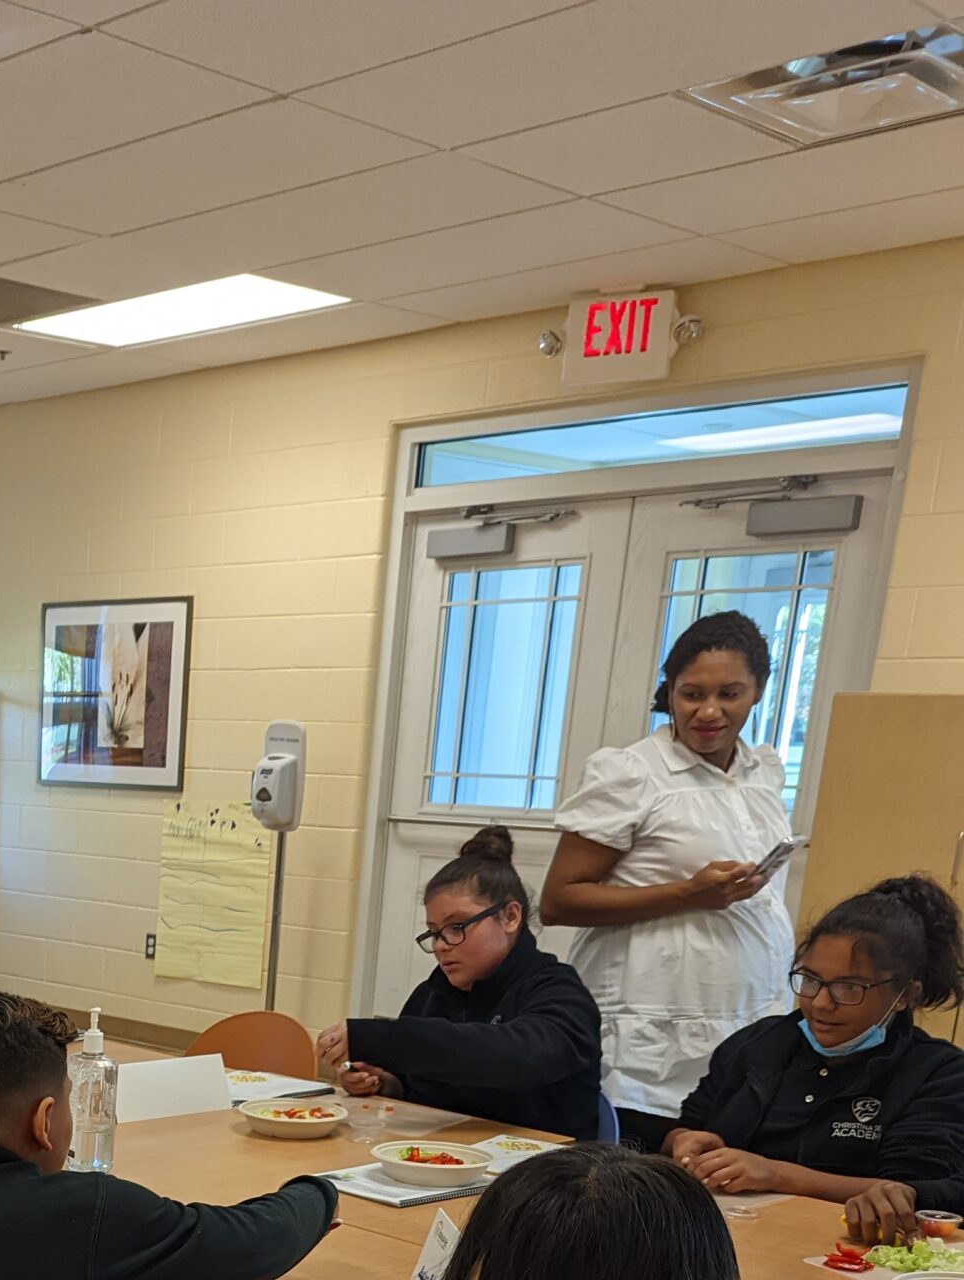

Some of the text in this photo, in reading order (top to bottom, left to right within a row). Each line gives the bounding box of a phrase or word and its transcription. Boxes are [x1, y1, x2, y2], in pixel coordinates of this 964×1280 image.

[583, 297, 659, 358] EXIT
[832, 1121, 874, 1131] CHRISTINA
[831, 1129, 882, 1140] ACADEM
